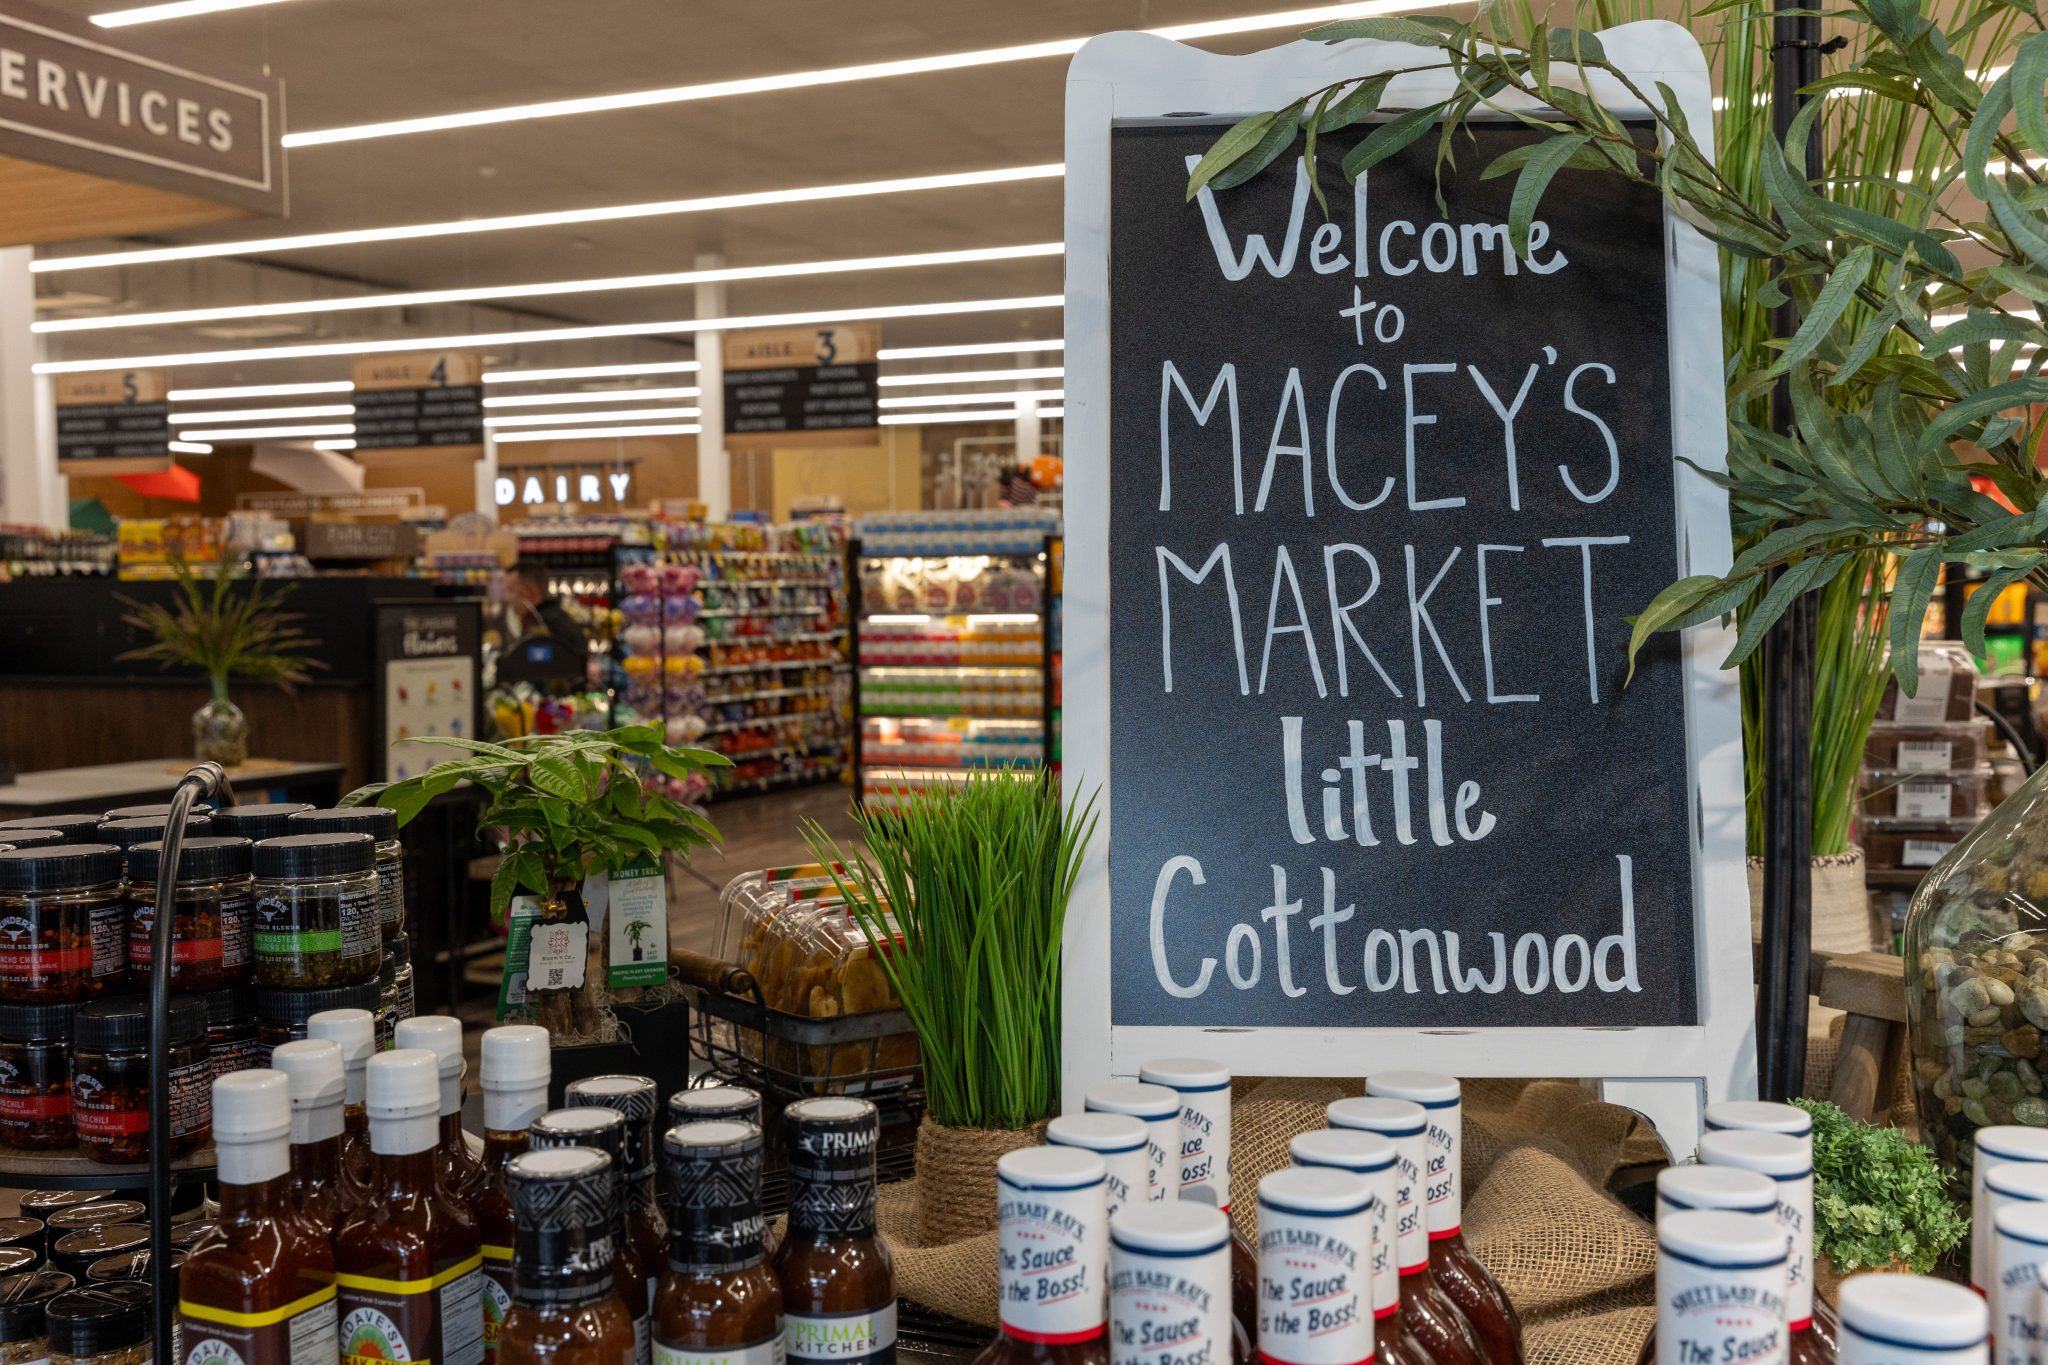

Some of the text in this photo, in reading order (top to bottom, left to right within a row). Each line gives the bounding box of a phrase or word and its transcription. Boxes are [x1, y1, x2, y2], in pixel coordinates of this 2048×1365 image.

[1185, 154, 1569, 281] Welcome
[1340, 285, 1405, 345] to
[816, 330, 837, 367] 3
[429, 356, 448, 387] 4
[123, 373, 139, 404] 5
[1159, 346, 1621, 517] MACEY'S
[494, 473, 630, 505] DAIRY
[1155, 535, 1630, 707] MARKET
[1280, 716, 1497, 847] little
[613, 869, 639, 878] MONEY
[223, 916, 241, 924] 120,
[256, 897, 288, 913] KINDER'S
[341, 907, 359, 917] 120,
[1149, 854, 1641, 998] Cottonwood
[1184, 1107, 1213, 1134] RAY'S
[1428, 1124, 1453, 1152] RAY'S
[1021, 1245, 1075, 1270] Sauce
[1008, 1264, 1086, 1303] the Boss!
[1261, 1274, 1347, 1301] The Sauce
[345, 1309, 398, 1343] DAVE'S
[1274, 1311, 1301, 1334] the
[1308, 1294, 1358, 1332] Boss!
[794, 1317, 877, 1343] PRIMAL
[795, 1336, 878, 1355] KITCHEN
[1141, 1317, 1199, 1344] Sauce
[1678, 1337, 1715, 1365] The
